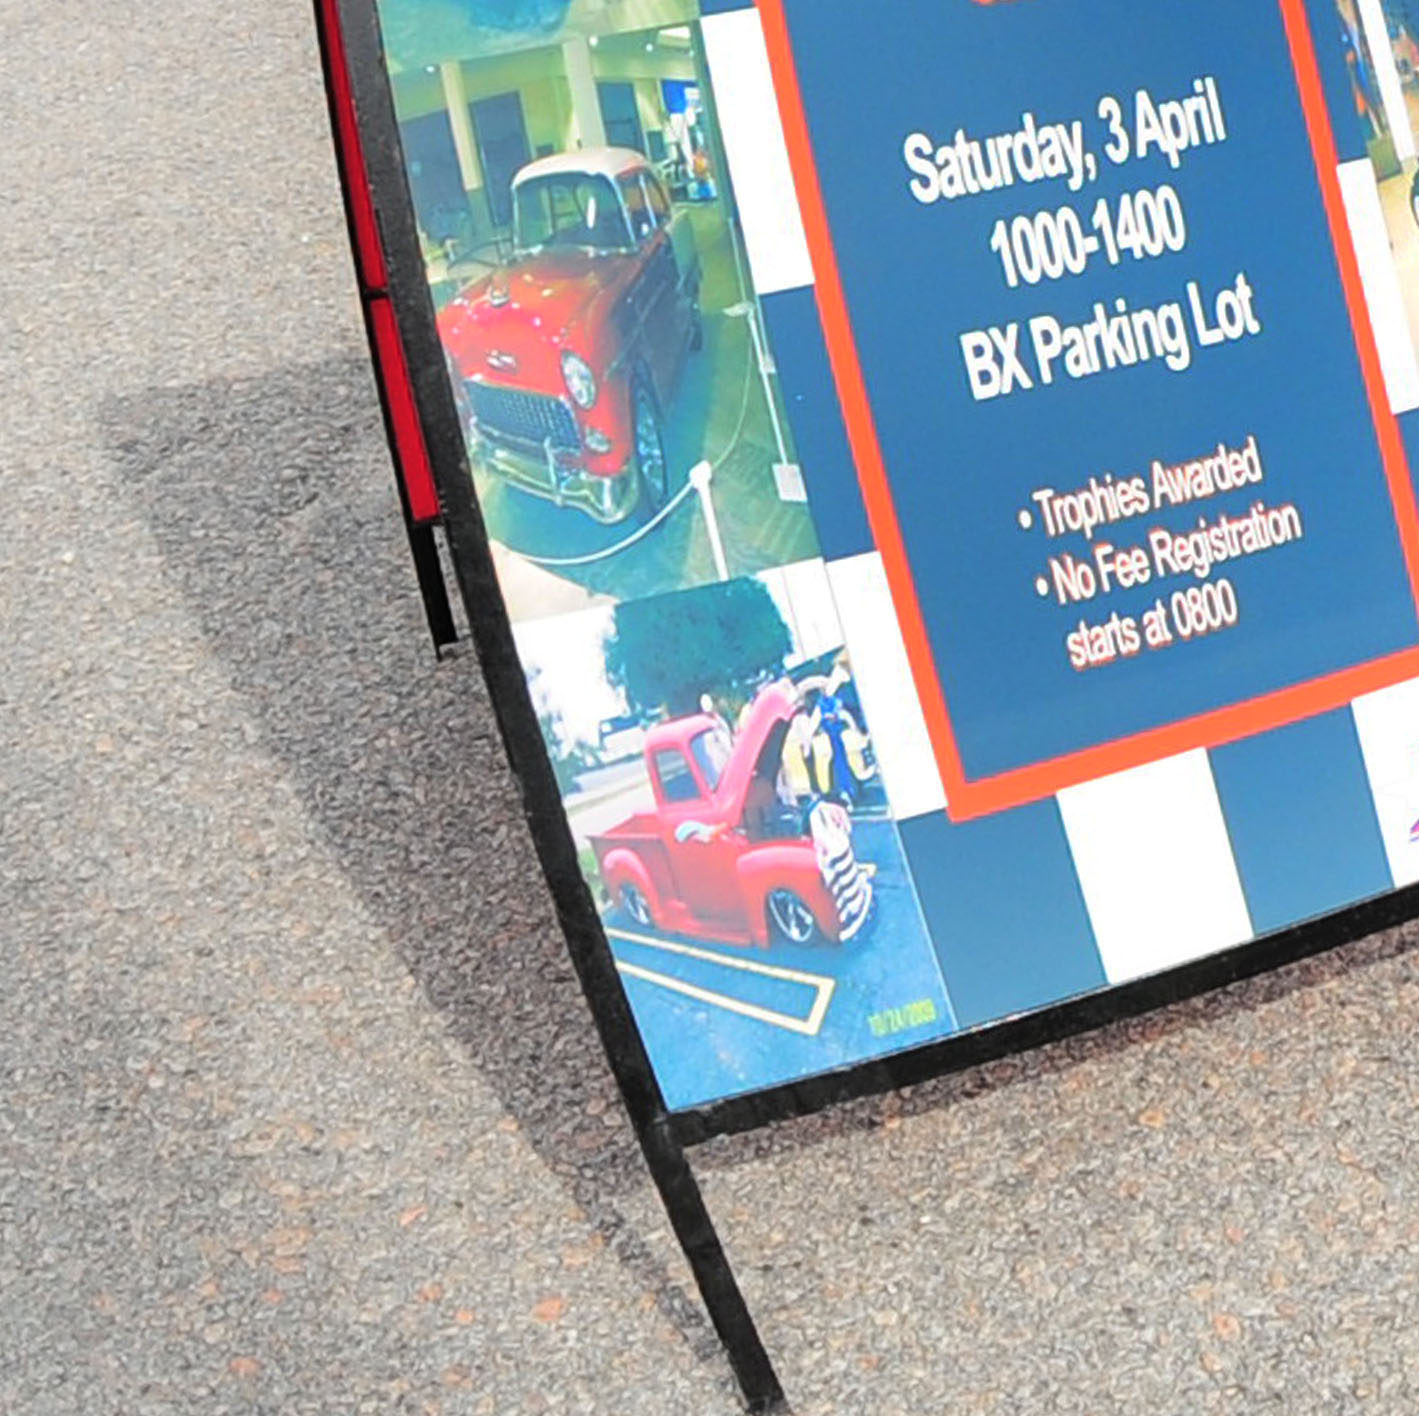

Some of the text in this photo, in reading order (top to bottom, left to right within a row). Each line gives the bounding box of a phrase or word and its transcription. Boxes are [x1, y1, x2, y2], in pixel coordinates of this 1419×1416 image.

[903, 76, 1227, 204] Saturday, 3 April
[990, 184, 1186, 288] 1000-1400
[959, 272, 1262, 401] BX Parking Lot
[1031, 434, 1264, 541] Trophies Awarded
[1049, 504, 1303, 605] No Fee Registration
[1066, 577, 1239, 668] starts at 0800
